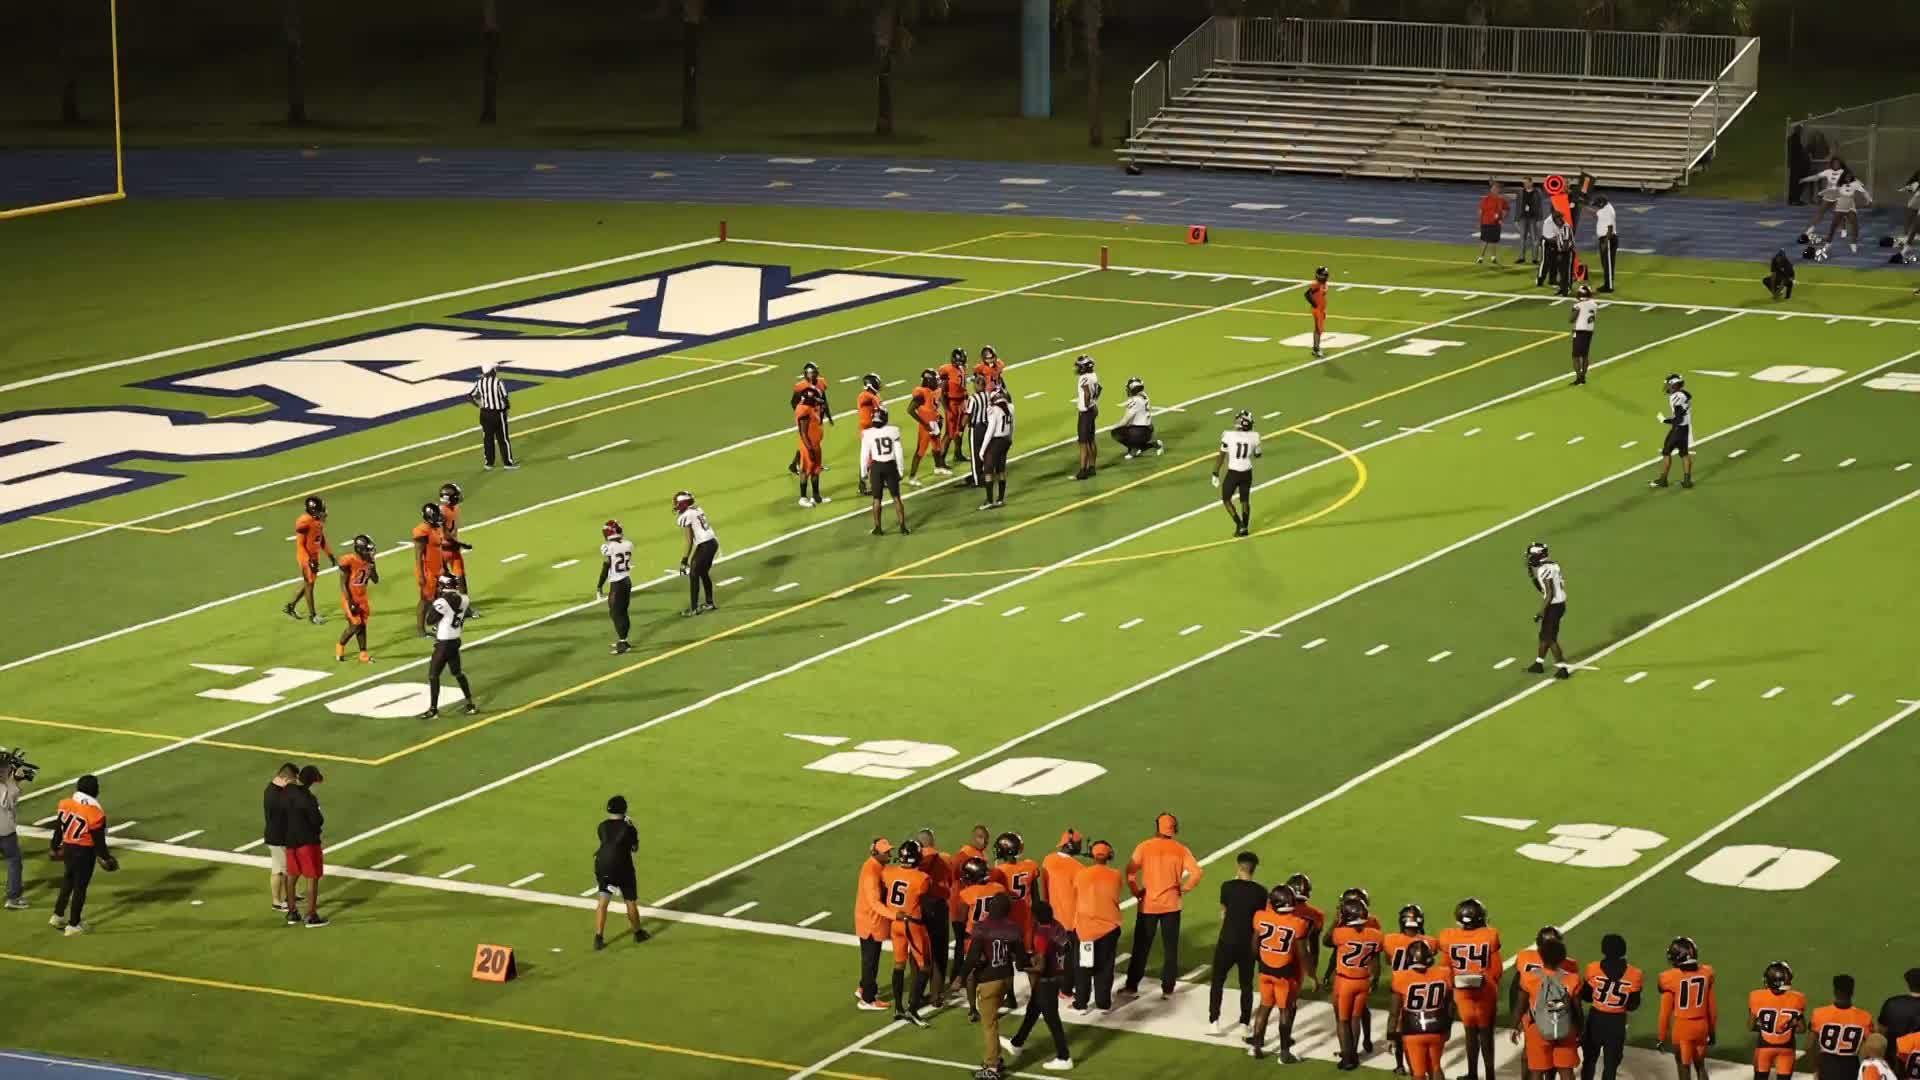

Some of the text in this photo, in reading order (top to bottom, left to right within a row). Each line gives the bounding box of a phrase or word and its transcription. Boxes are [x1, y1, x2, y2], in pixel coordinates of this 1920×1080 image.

[875, 436, 893, 456] 19
[1235, 442, 1249, 460] 11
[614, 551, 632, 573] 22
[890, 880, 908, 907] 6
[1012, 872, 1028, 901] 5
[1259, 922, 1295, 954] 23
[476, 947, 507, 975] 20
[1449, 942, 1490, 972] 54
[1405, 980, 1446, 1011] 60
[1596, 975, 1632, 1008] 35
[1679, 976, 1706, 1009] 17
[1819, 1023, 1864, 1056] 89
